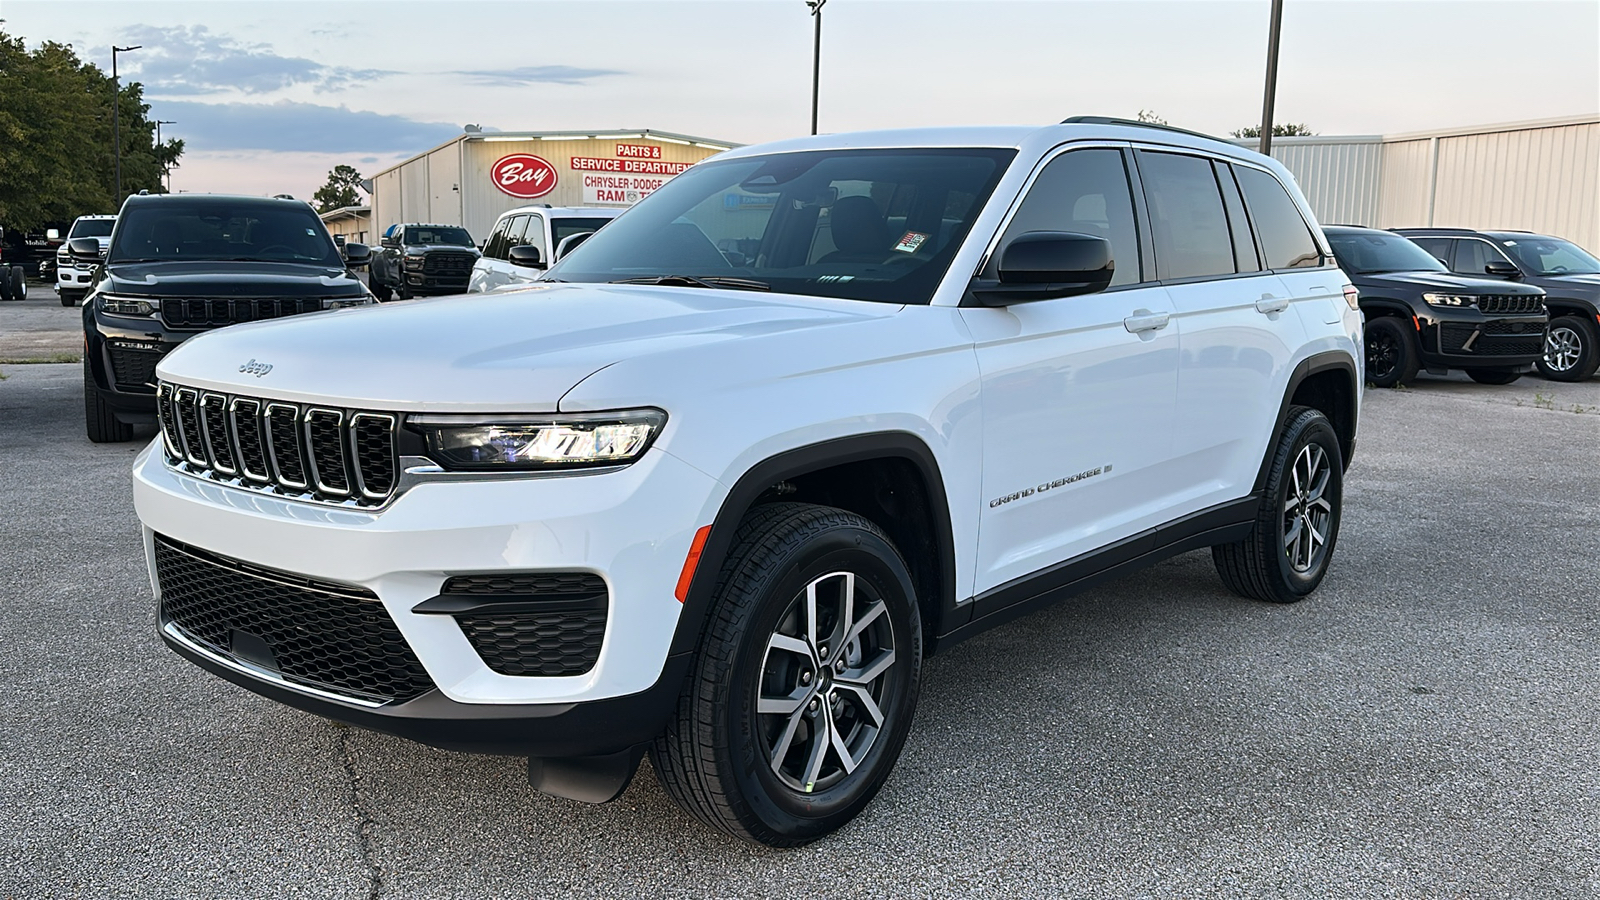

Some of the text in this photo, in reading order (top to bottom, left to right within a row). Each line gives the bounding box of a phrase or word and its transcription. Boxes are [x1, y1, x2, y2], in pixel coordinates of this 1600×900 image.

[617, 145, 660, 158] PARTS &
[500, 162, 550, 187] Bay
[572, 157, 695, 174] SERVICE DEPARTMEN
[597, 190, 625, 202] RAM
[238, 358, 274, 378] Jeep
[989, 467, 1101, 508] GRAND CHEROKEE
